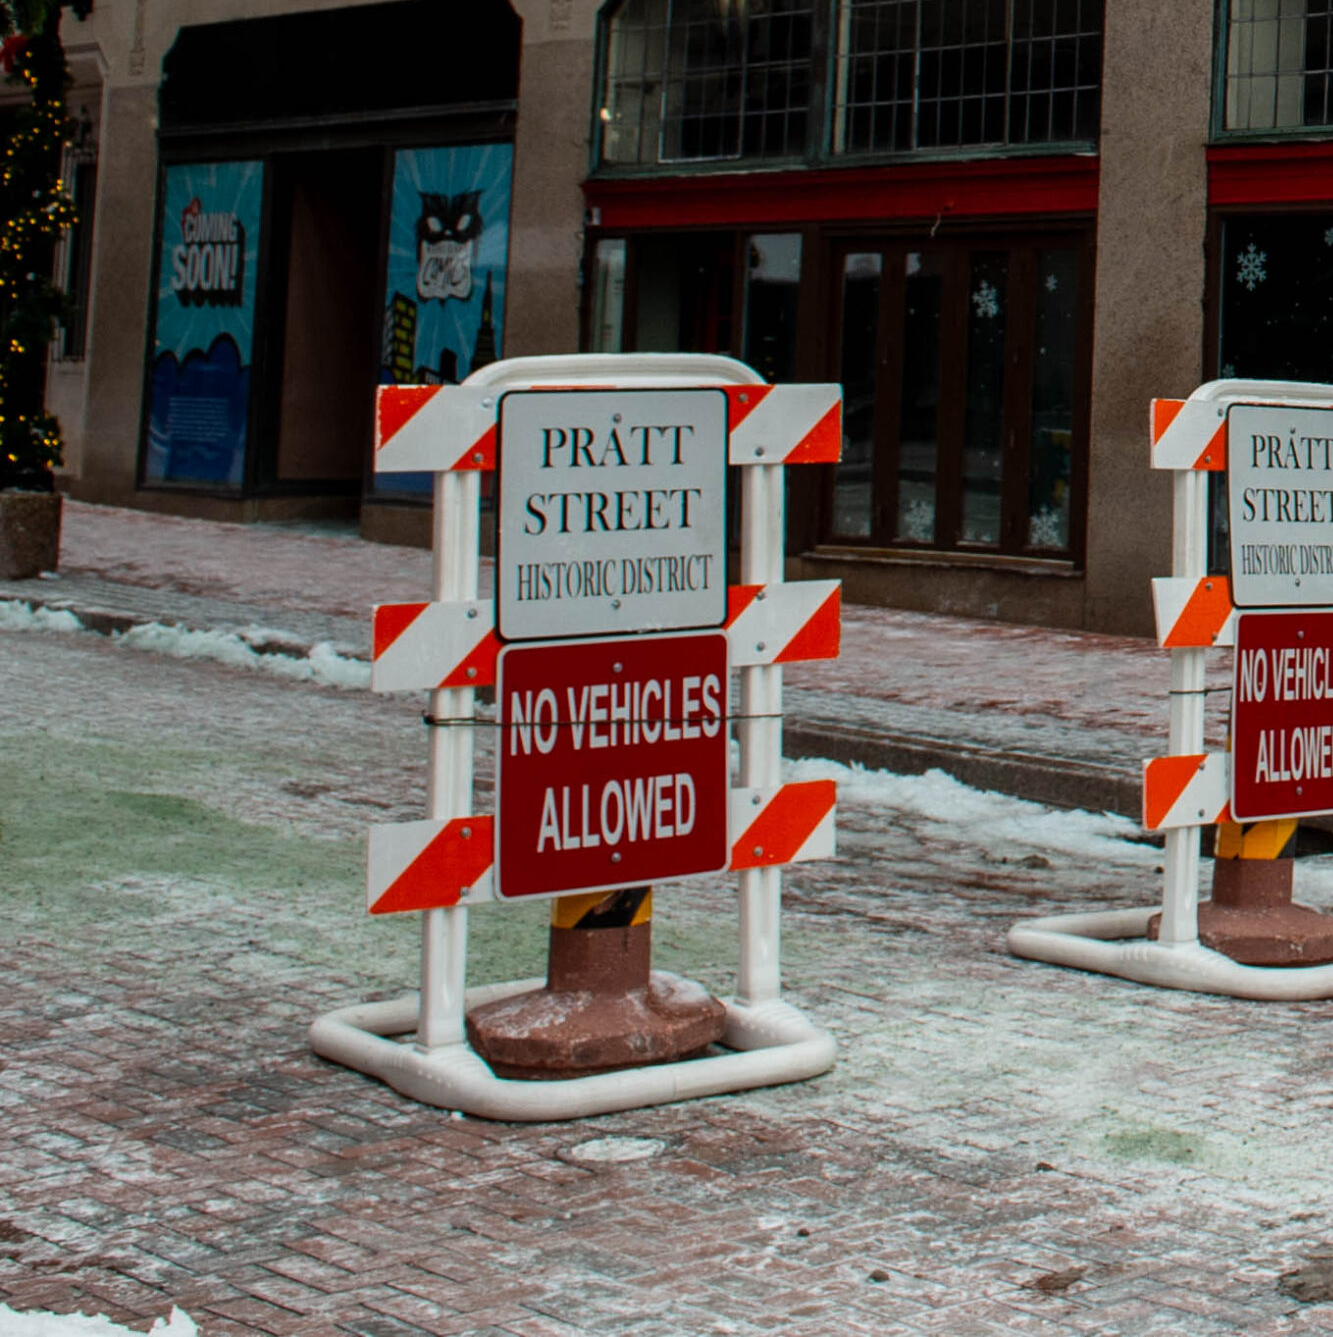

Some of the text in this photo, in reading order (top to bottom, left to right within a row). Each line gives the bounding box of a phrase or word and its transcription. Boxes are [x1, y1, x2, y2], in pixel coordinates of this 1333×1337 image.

[184, 211, 237, 243] COMING
[171, 244, 237, 292] SOON!
[541, 425, 696, 469] PRATT
[524, 488, 702, 536] STREET
[517, 554, 714, 602] HISTORIC DISTRICT
[1241, 544, 1297, 576] HISTORIC
[1239, 647, 1269, 703] NO
[510, 673, 721, 757] NO VEHICLES
[537, 773, 696, 853] ALLOWED
